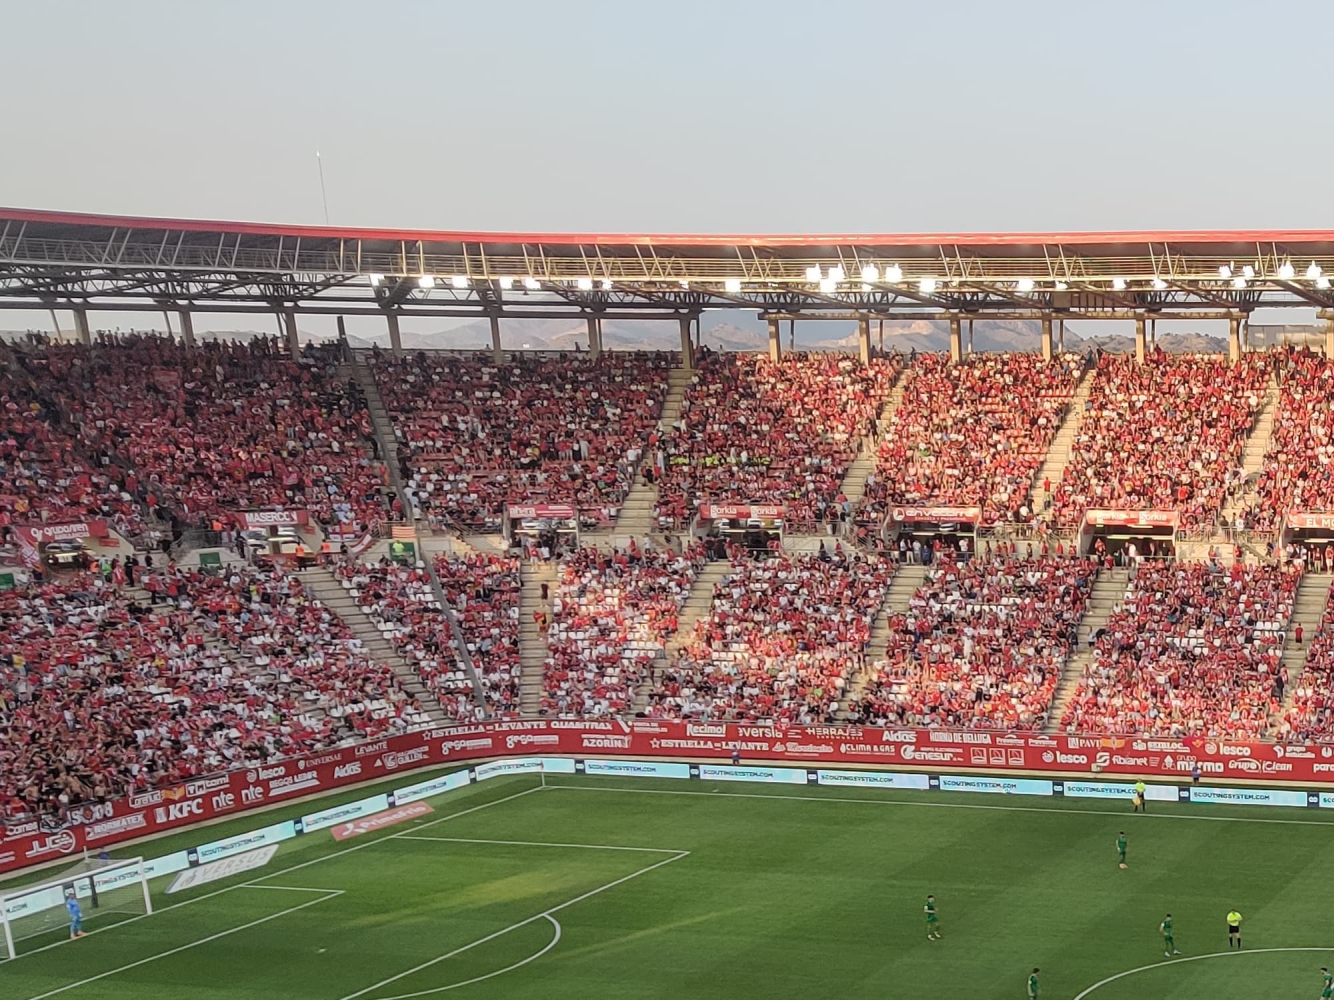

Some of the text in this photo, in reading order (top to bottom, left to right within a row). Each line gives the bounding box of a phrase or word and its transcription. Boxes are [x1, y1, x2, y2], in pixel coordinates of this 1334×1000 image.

[1306, 519, 1318, 527] EL
[432, 721, 547, 738] ESTRELLA LEVANTE
[661, 739, 713, 749] ESTRELLA
[722, 741, 768, 751] LEVANTE
[847, 744, 895, 753] CLIMA GAS
[1193, 791, 1270, 801] SCOUTINGSYSTEM.COM
[169, 798, 204, 821] KFC
